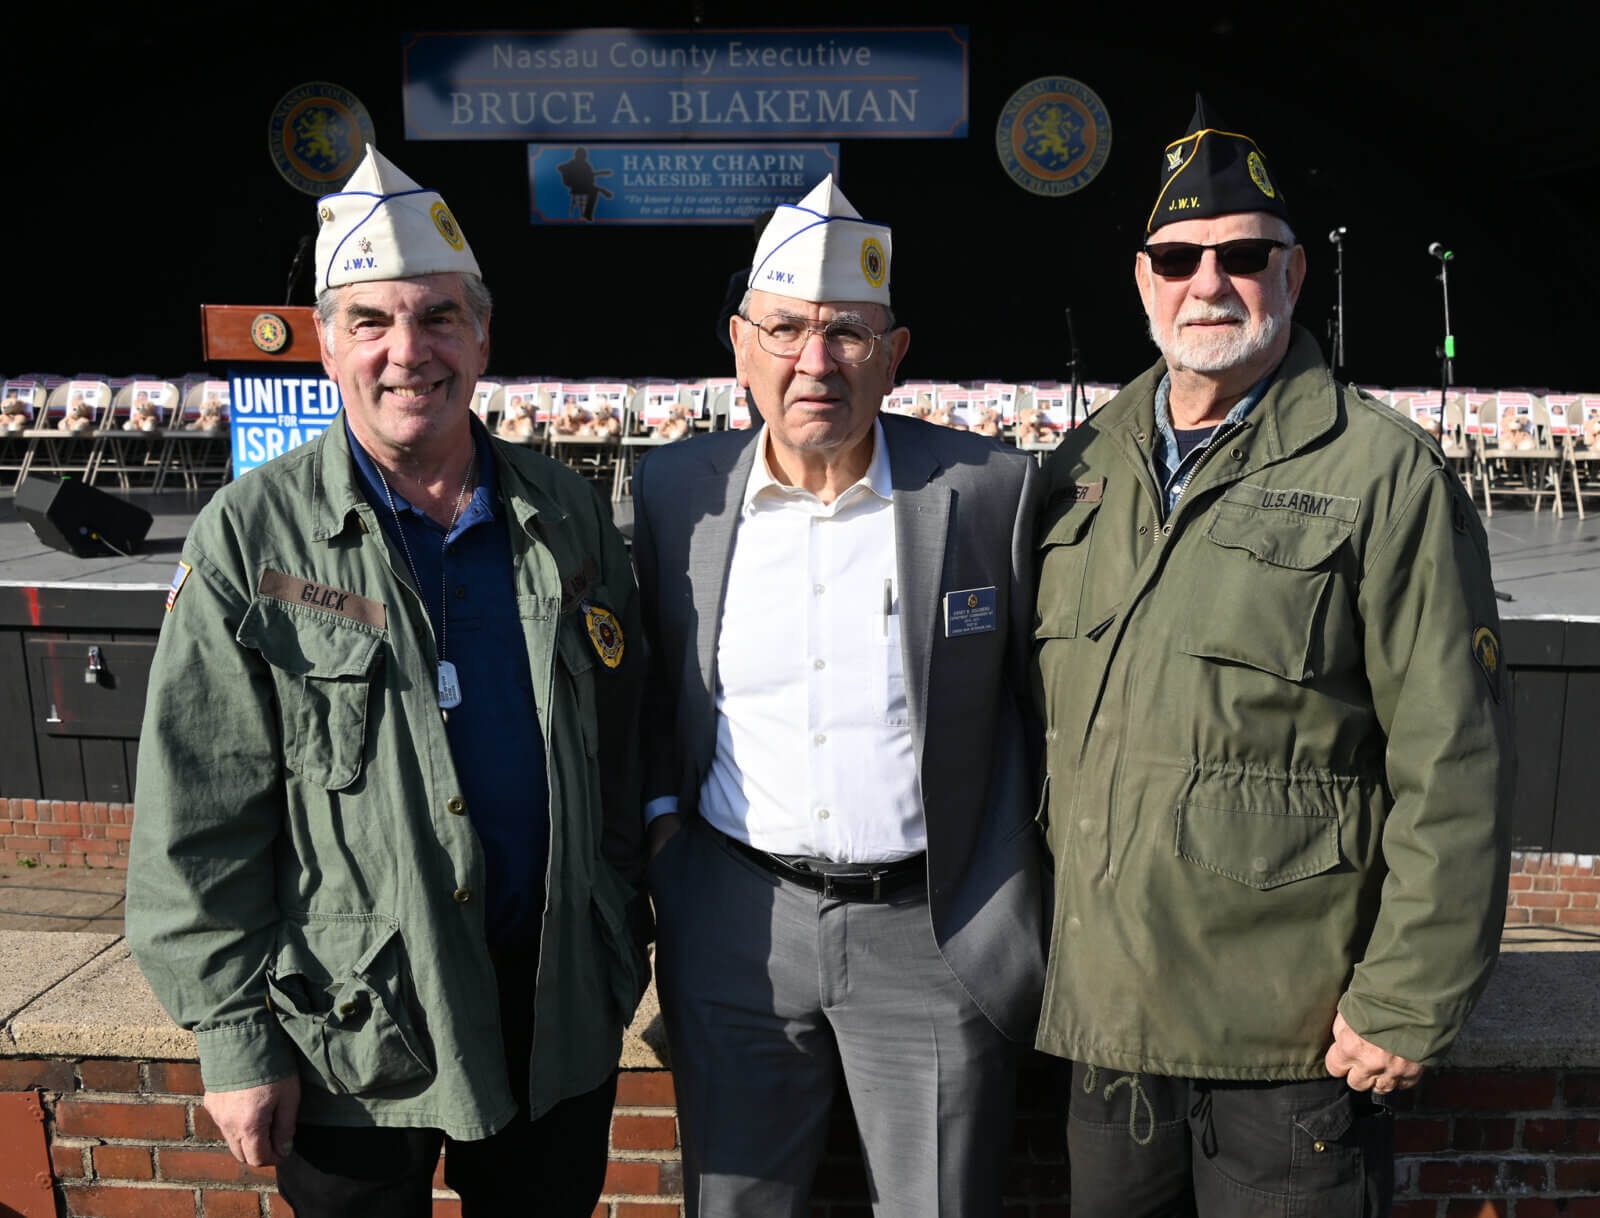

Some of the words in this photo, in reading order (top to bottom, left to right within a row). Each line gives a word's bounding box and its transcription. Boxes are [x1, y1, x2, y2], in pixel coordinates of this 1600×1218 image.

[492, 41, 598, 70] Nassau
[608, 41, 717, 74] County
[729, 40, 872, 68] Executive
[450, 90, 597, 125] BRUCE
[610, 90, 652, 125] A.
[668, 87, 919, 125] BLAKEMAN
[623, 154, 704, 172] HARRY
[712, 154, 805, 172] CHAPIN
[623, 172, 713, 188] LAKESIDE
[720, 172, 806, 188] THEATRE
[1168, 195, 1201, 212] J.W.V.
[343, 256, 379, 272] J.W.V.
[766, 269, 796, 285] J.W.V.
[233, 377, 340, 415] UNITED
[277, 414, 298, 427] FOR
[236, 426, 323, 463] ISRA
[301, 583, 349, 612] GLICK
